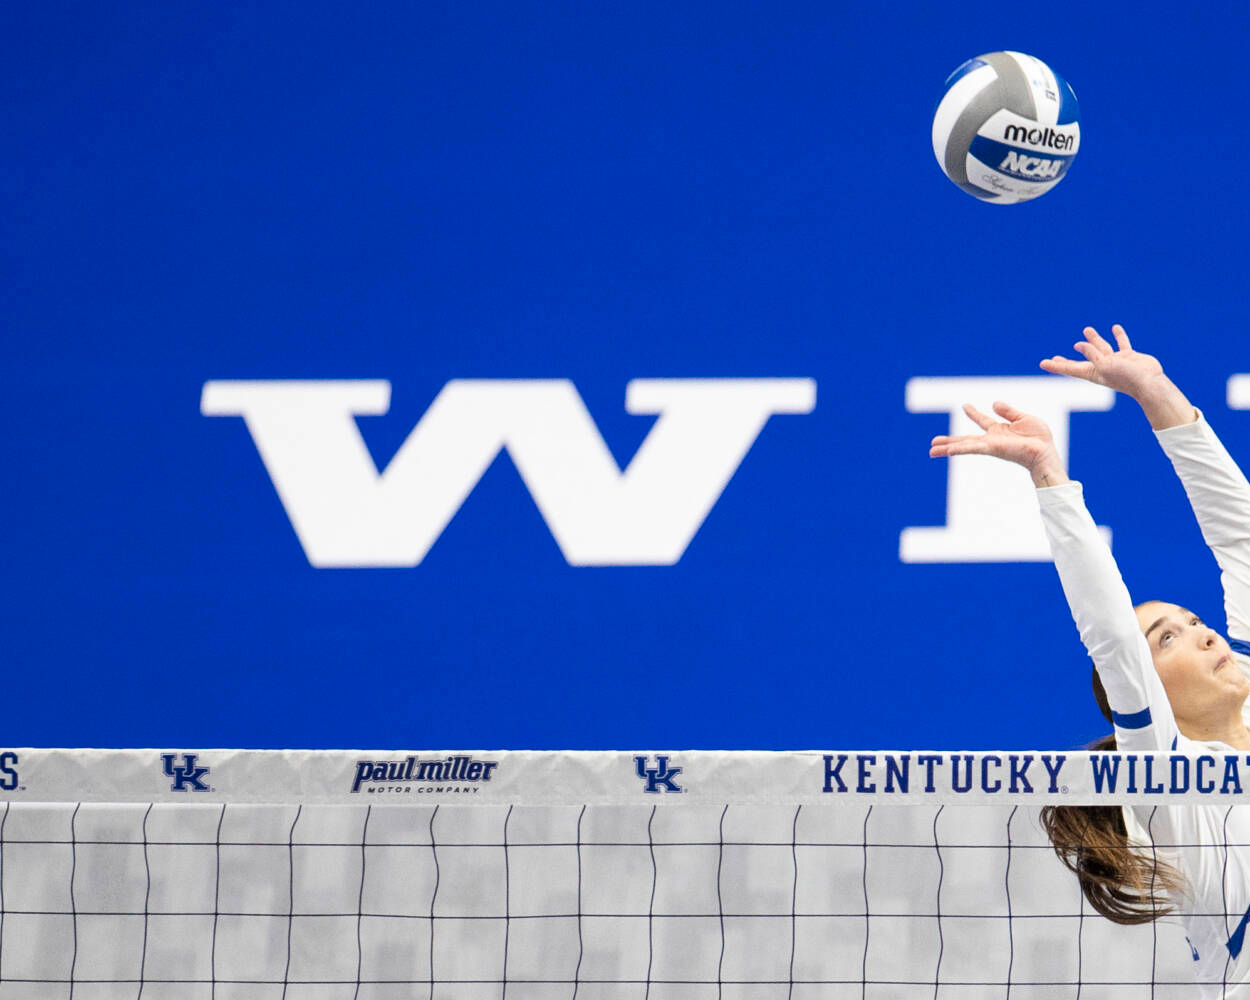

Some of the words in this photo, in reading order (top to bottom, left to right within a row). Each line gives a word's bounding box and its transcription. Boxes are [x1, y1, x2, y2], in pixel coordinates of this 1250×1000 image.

[1004, 124, 1074, 151] molten
[999, 151, 1064, 178] NCAA
[161, 753, 210, 792] UK
[351, 755, 418, 793] paul
[418, 755, 498, 782] miller
[633, 754, 683, 793] UK
[822, 755, 1067, 793] KENTUCKY
